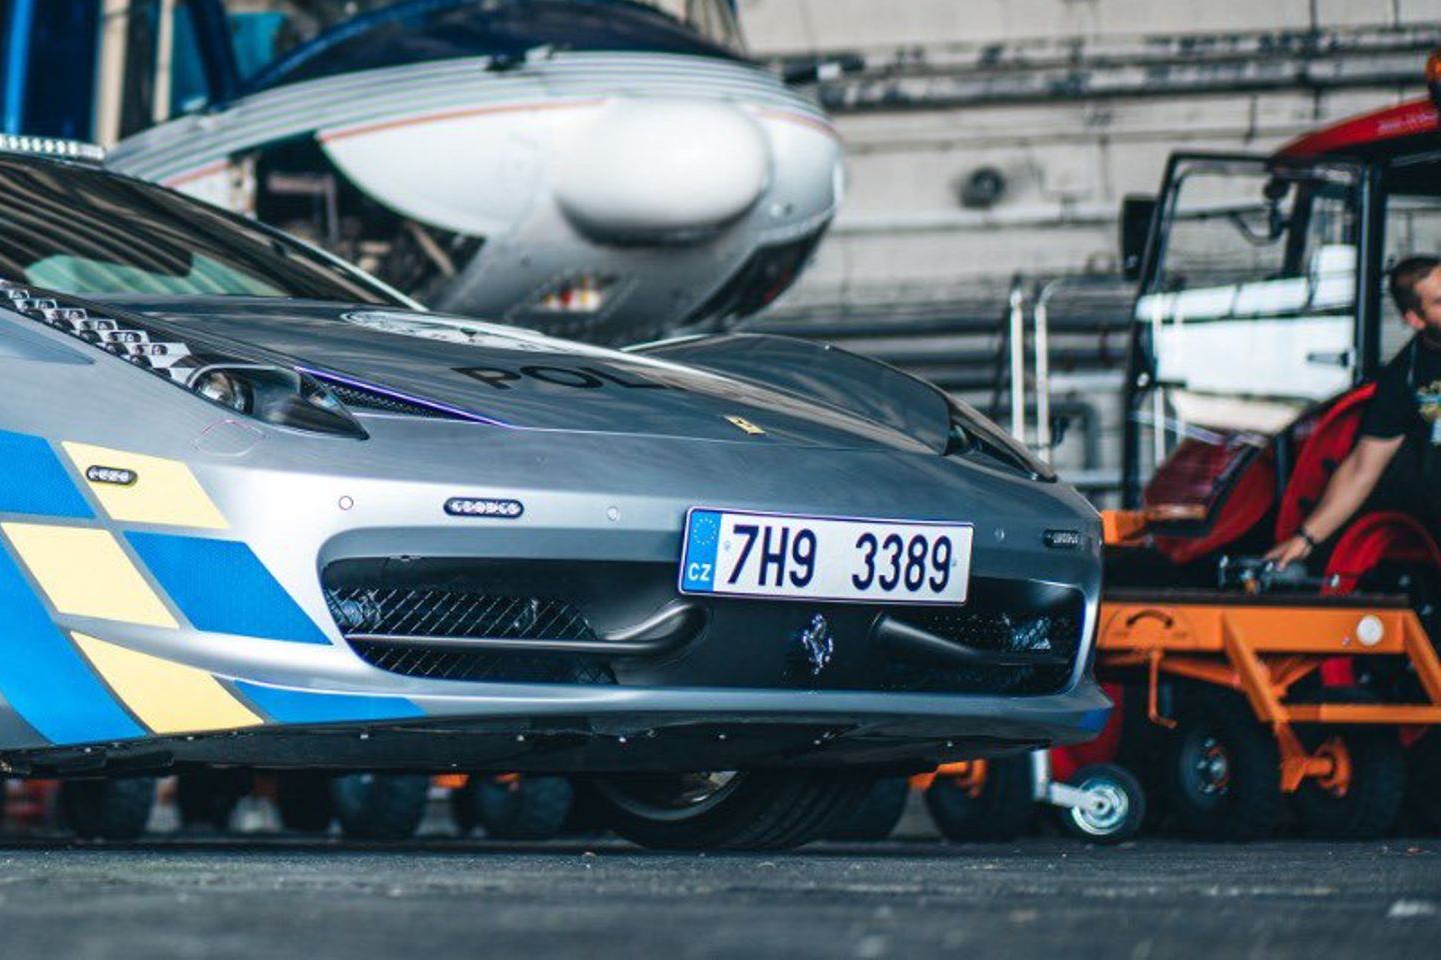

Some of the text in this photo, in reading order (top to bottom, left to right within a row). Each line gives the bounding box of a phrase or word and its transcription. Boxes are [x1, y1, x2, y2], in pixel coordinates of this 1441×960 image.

[449, 365, 691, 390] POL
[727, 524, 952, 593] 7H9 3389
[687, 562, 711, 582] CZ
